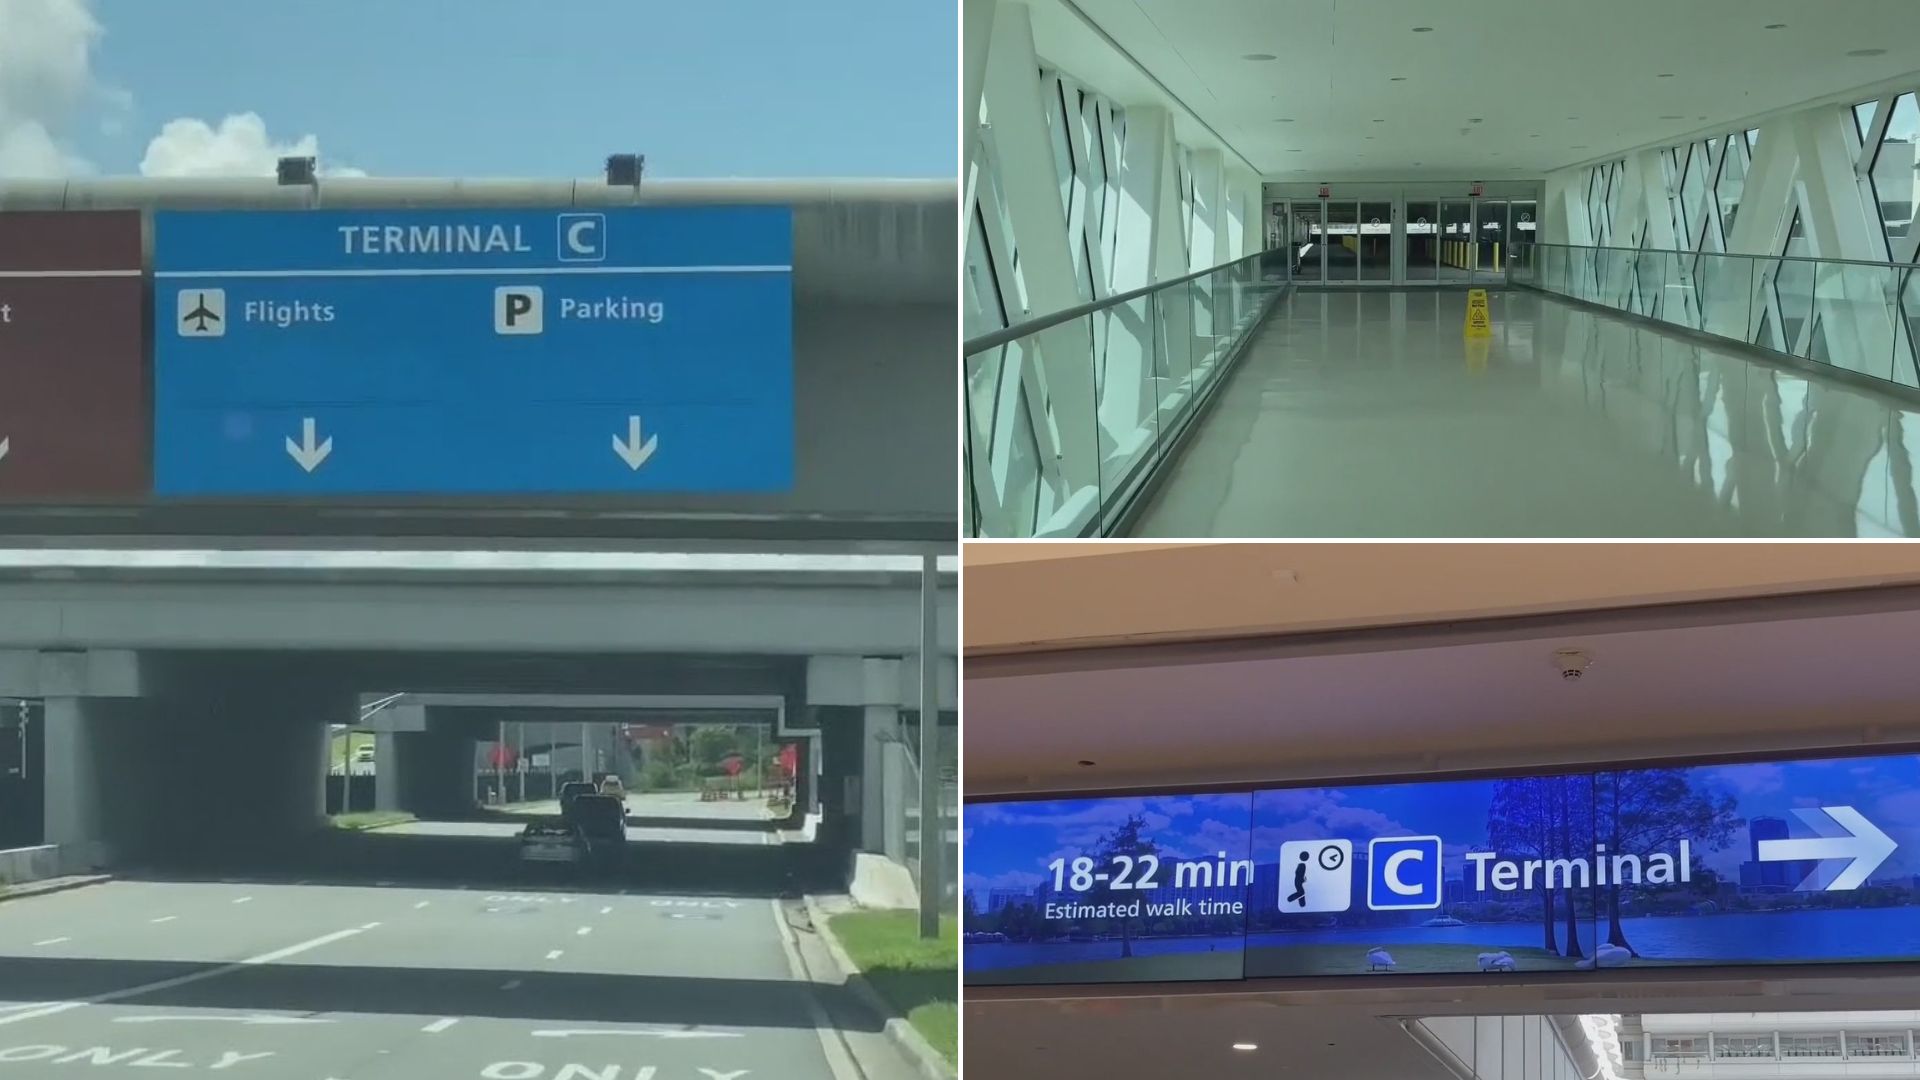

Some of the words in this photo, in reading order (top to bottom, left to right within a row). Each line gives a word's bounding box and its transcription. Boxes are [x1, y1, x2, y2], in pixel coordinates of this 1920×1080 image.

[339, 225, 530, 254] TERMINAL
[567, 220, 596, 253] C
[245, 300, 336, 328] Flights
[506, 294, 532, 326] P
[560, 297, 664, 324] Parking
[1048, 854, 1159, 893] 18-22
[1174, 850, 1255, 889] min
[1383, 849, 1424, 896] C
[1465, 839, 1691, 892] Terminal
[1045, 899, 1140, 920] Estimated
[1146, 898, 1192, 917] walk
[1198, 898, 1244, 916] time
[0, 1044, 276, 1069] ONLY
